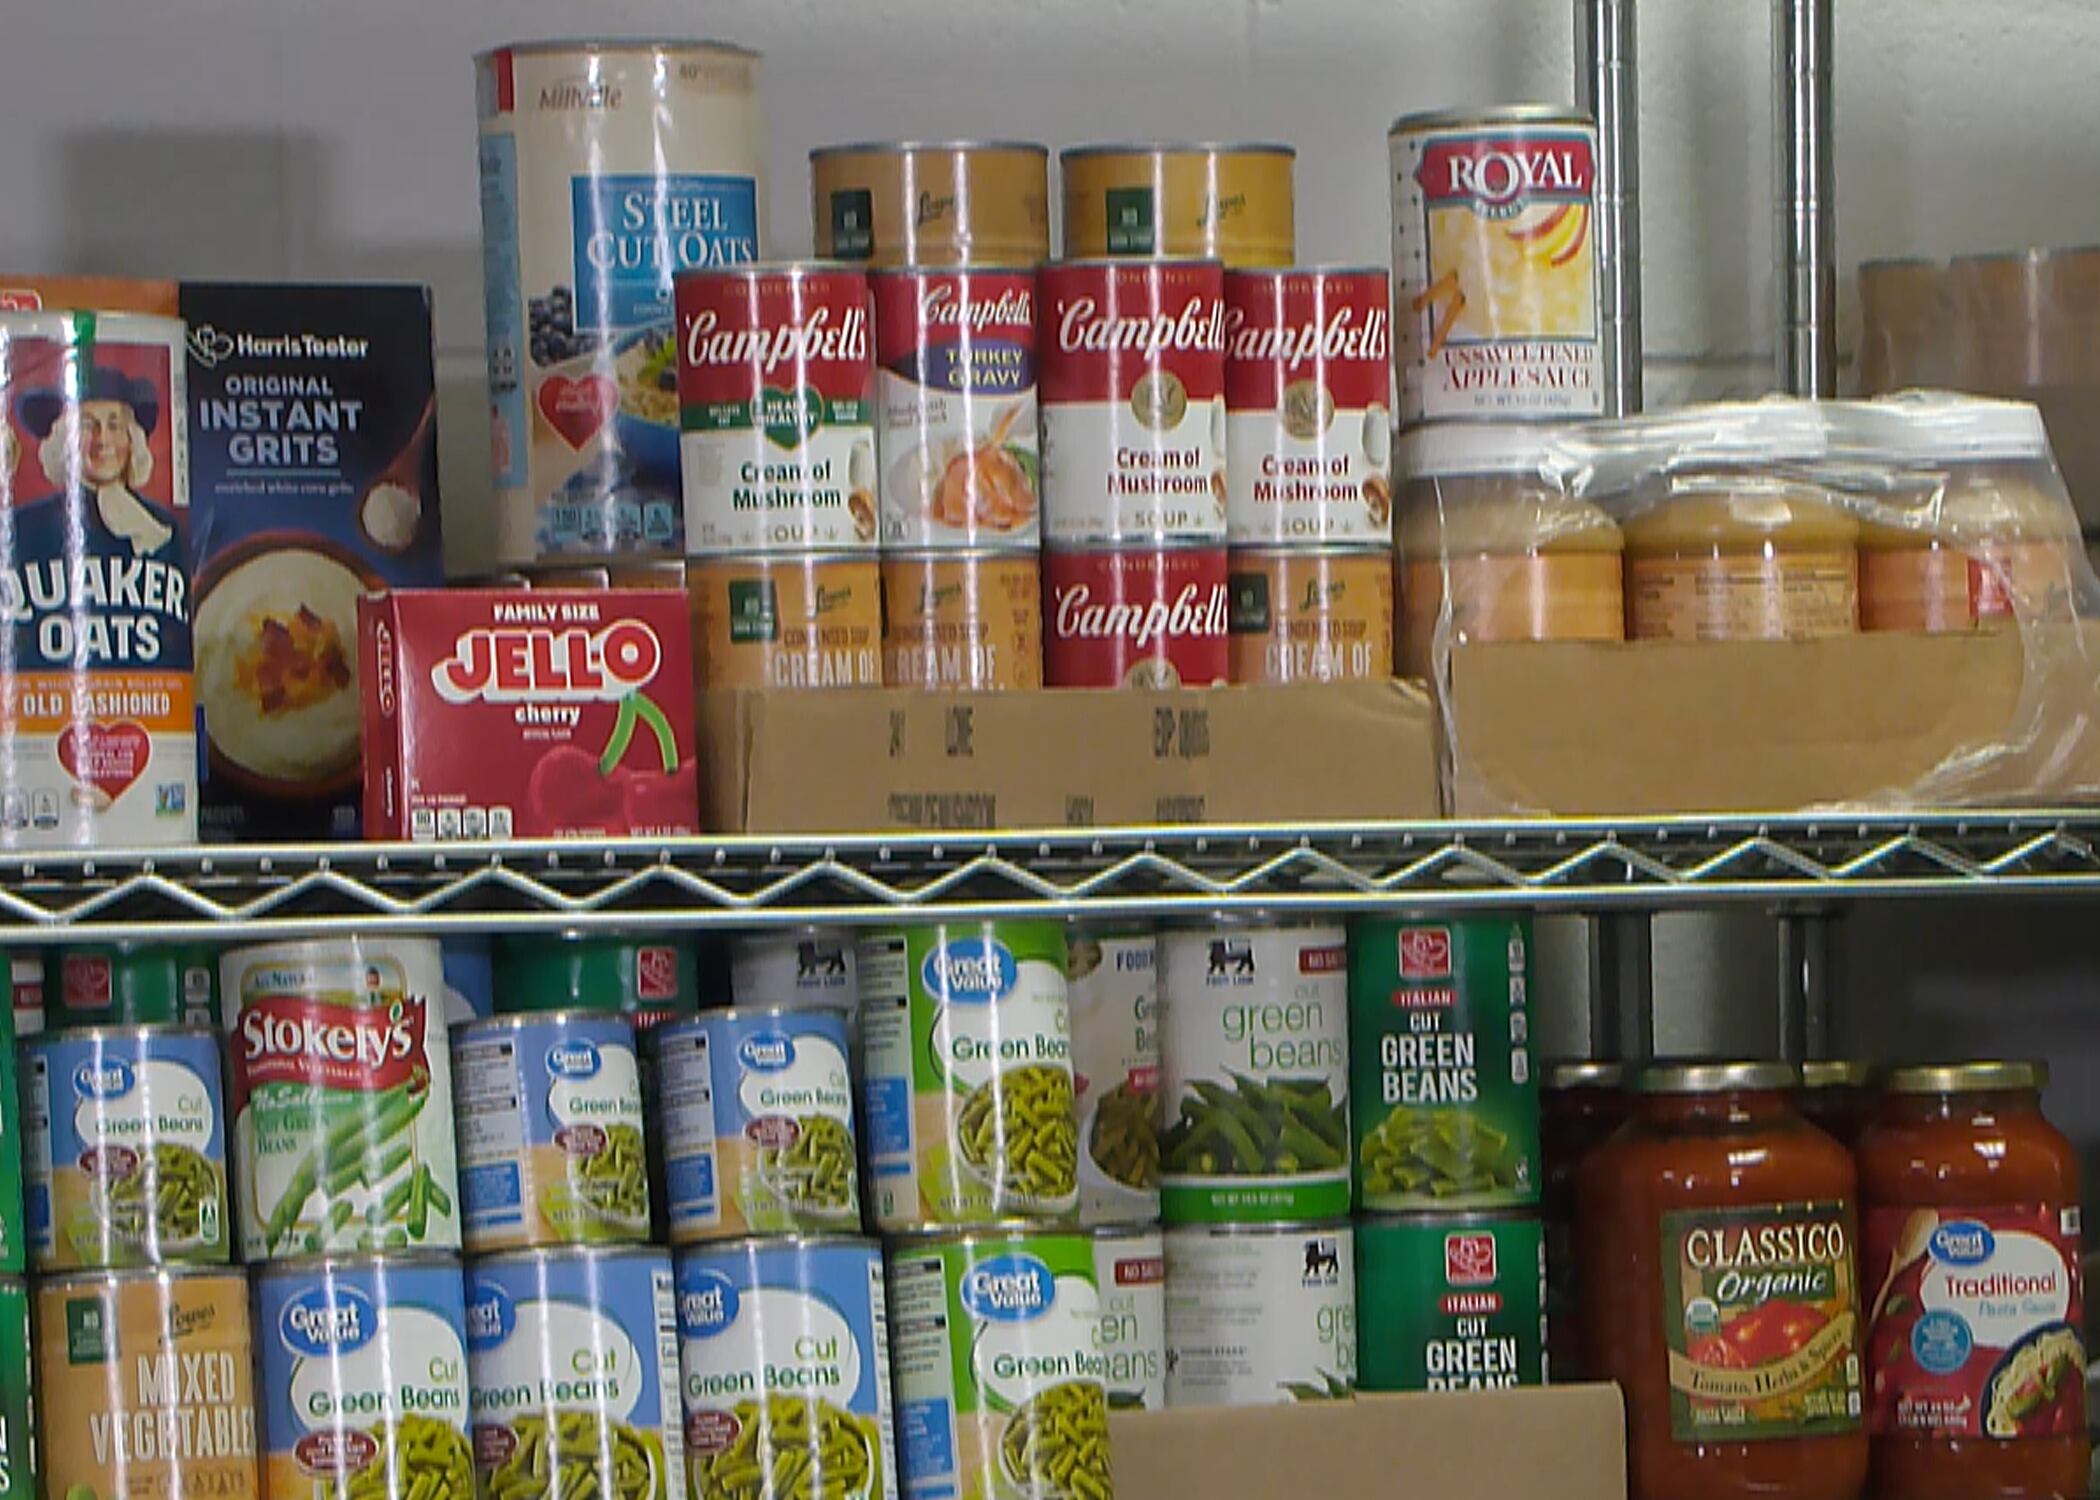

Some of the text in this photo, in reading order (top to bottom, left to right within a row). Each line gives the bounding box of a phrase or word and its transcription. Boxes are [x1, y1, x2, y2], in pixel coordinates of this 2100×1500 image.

[1448, 148, 1583, 196] ROYAL
[622, 191, 728, 231] STEEL
[678, 231, 752, 268] OATS
[946, 348, 1023, 366] TURKEY
[1445, 344, 1593, 366] UNSWEETENED
[225, 376, 333, 396] ORIGINAL
[948, 369, 1022, 387] GRAVY
[1443, 367, 1591, 392] APPLESAUCE
[200, 398, 363, 431] INSTANT
[229, 433, 339, 465] GRITS
[1117, 447, 1200, 470] Cream of
[740, 457, 832, 484] Cream of
[1262, 455, 1349, 476] Cream of
[1107, 473, 1208, 495] Mushroom
[1254, 481, 1358, 503] Mushroom
[733, 486, 841, 512] Mushroom
[0, 555, 185, 622] QUAKER
[494, 603, 600, 621] FAMILY SIZE
[39, 614, 161, 662] OATS
[784, 625, 848, 648] CONNSED
[775, 651, 852, 688] CREAM
[1266, 640, 1372, 682] CREAM OF
[23, 691, 63, 716] OLD
[515, 704, 581, 727] cherry
[1400, 991, 1451, 1006] ITALIAN
[1222, 1001, 1322, 1043] green
[1410, 1012, 1441, 1032] CUT
[1250, 1034, 1343, 1070] beans
[1381, 1033, 1475, 1068] GREEN
[760, 1088, 813, 1107] Green
[1382, 1068, 1478, 1103] BEANS
[569, 1098, 617, 1114] Green
[95, 1115, 203, 1133] Green Beans
[1687, 1222, 1844, 1268] CLASSICO
[973, 1267, 1040, 1294] Great
[1717, 1266, 1827, 1306] Organic
[1946, 1271, 2057, 1299] Traditional
[291, 1300, 360, 1328] Great
[1446, 1296, 1497, 1312] ITALIAN
[1457, 1317, 1489, 1337] CUT
[572, 1347, 616, 1375] Cut
[795, 1336, 837, 1361] Cut
[1427, 1337, 1517, 1374] GREEN
[429, 1357, 459, 1382] Cut
[994, 1350, 1070, 1379] Green
[138, 1352, 236, 1406] MIXED
[540, 1377, 620, 1400] Beans
[688, 1363, 840, 1397] Green Beans
[309, 1384, 460, 1418] Green Beans
